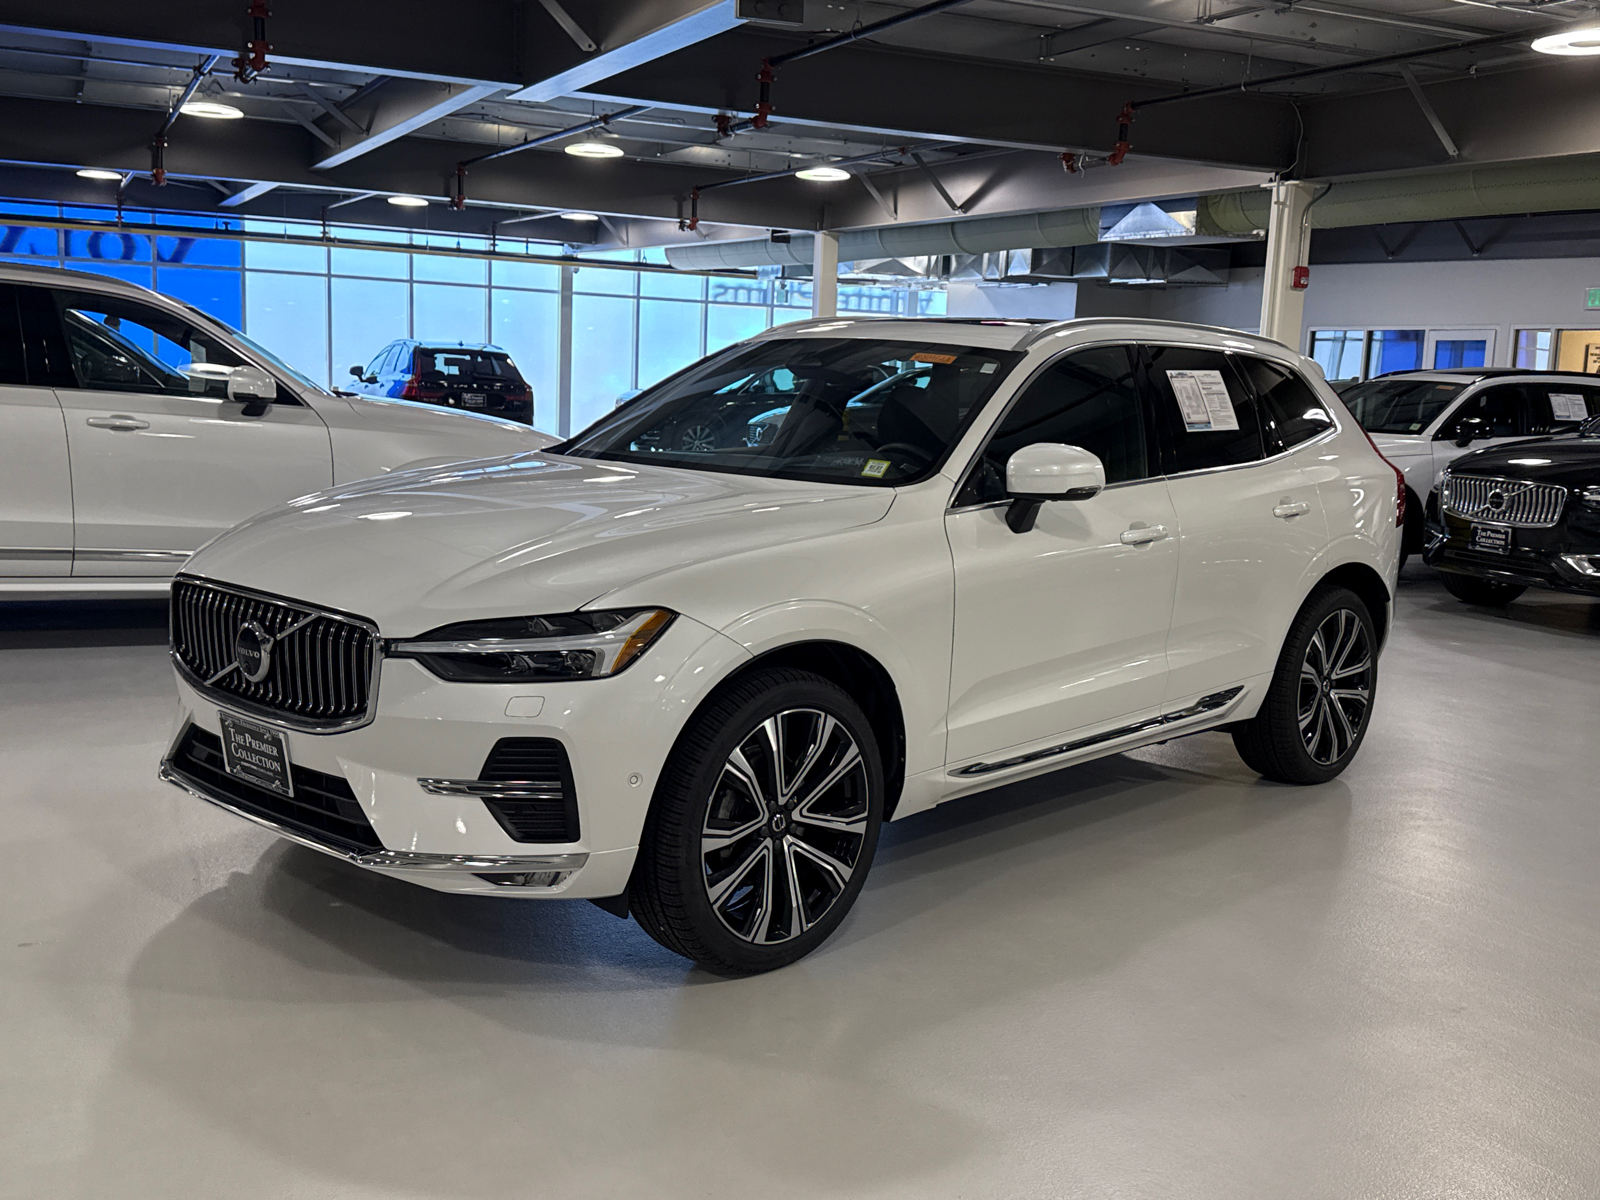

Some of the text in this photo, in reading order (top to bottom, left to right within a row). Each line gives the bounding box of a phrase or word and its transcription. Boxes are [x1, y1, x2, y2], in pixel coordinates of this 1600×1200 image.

[238, 646, 260, 658] VOLVO
[229, 727, 279, 757] THE PREMIER
[231, 742, 281, 772] COLLECTION
